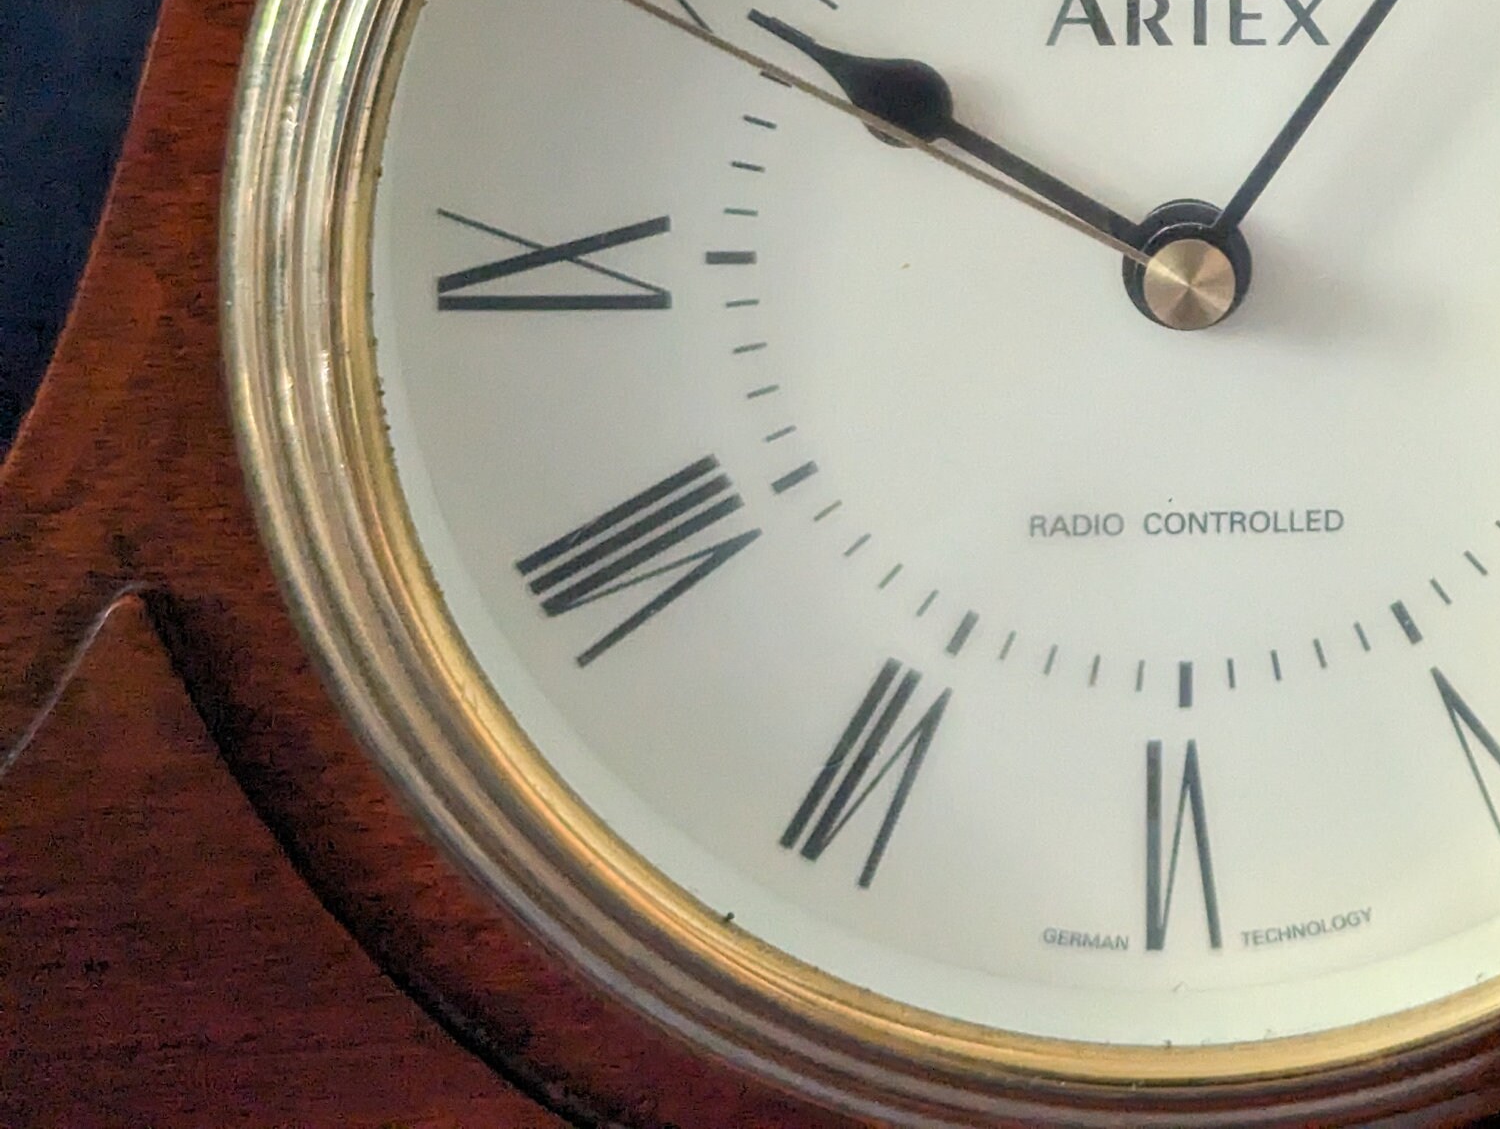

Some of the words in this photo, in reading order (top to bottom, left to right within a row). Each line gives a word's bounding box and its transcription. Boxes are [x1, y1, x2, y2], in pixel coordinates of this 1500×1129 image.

[436, 208, 671, 310] IX
[516, 453, 762, 668] VIII
[1028, 513, 1125, 538] RADIO
[1143, 509, 1345, 536] CONTROLLED
[780, 658, 952, 889] VII
[1145, 739, 1222, 951] VI
[1043, 927, 1130, 951] GERMAN
[1240, 907, 1374, 947] TECHNOLOGY
